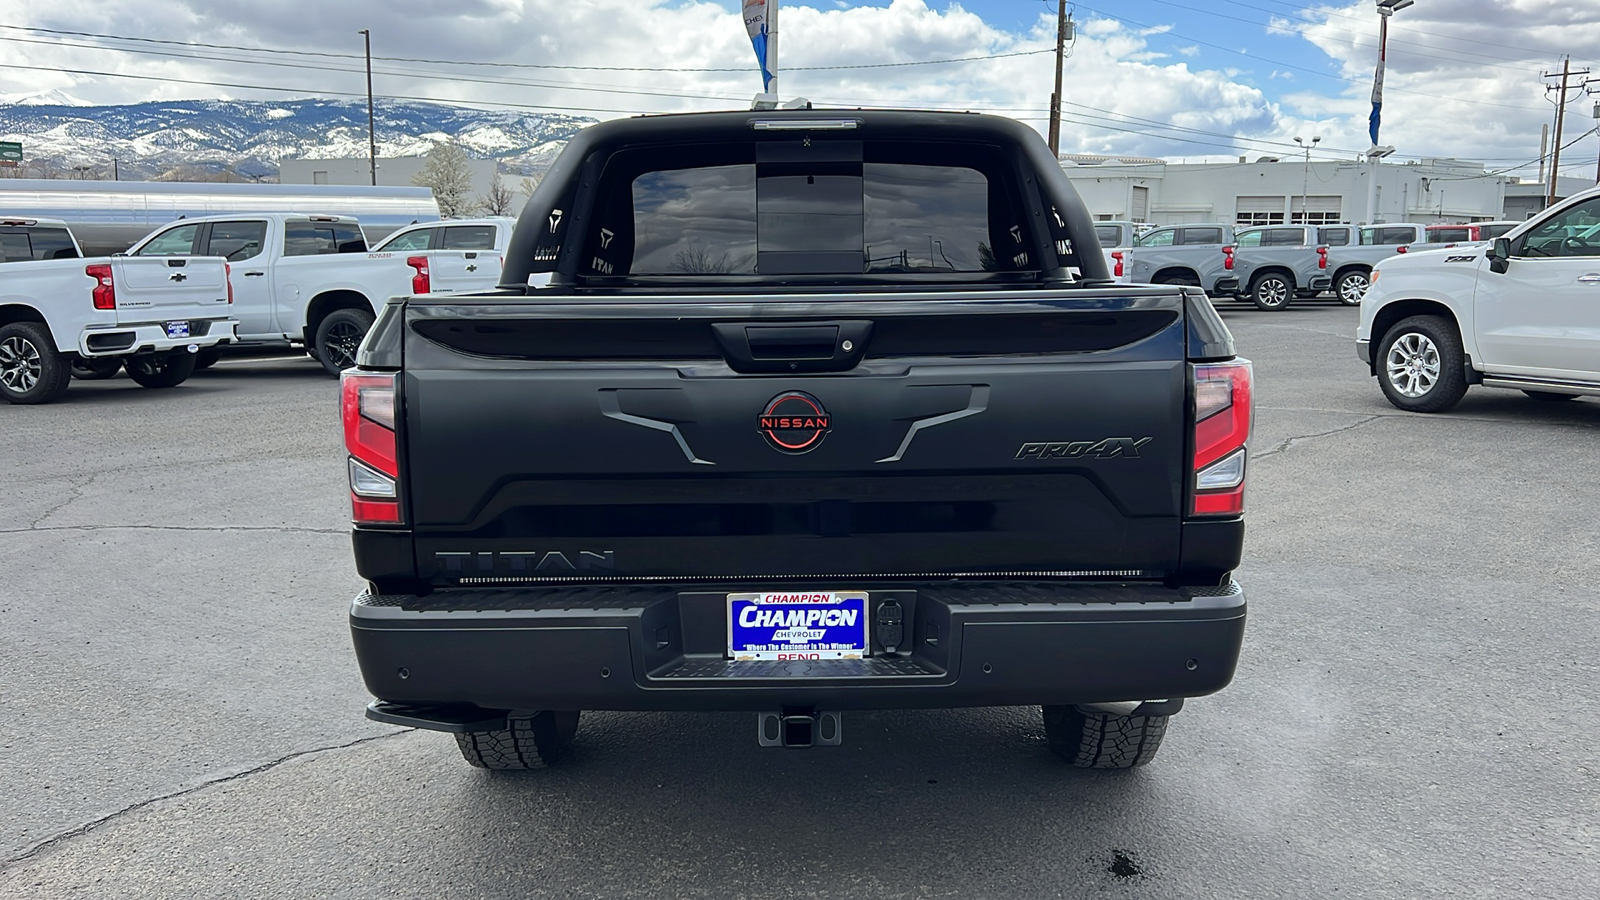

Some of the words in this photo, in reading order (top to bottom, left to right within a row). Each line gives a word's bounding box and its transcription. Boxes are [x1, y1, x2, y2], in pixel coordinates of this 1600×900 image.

[761, 418, 827, 428] NISSAN
[435, 550, 615, 571] TITAN
[765, 594, 830, 604] CHAMPION
[738, 605, 858, 628] CHAMPION
[768, 643, 779, 651] The
[780, 643, 810, 651] Customer
[818, 643, 830, 651] The
